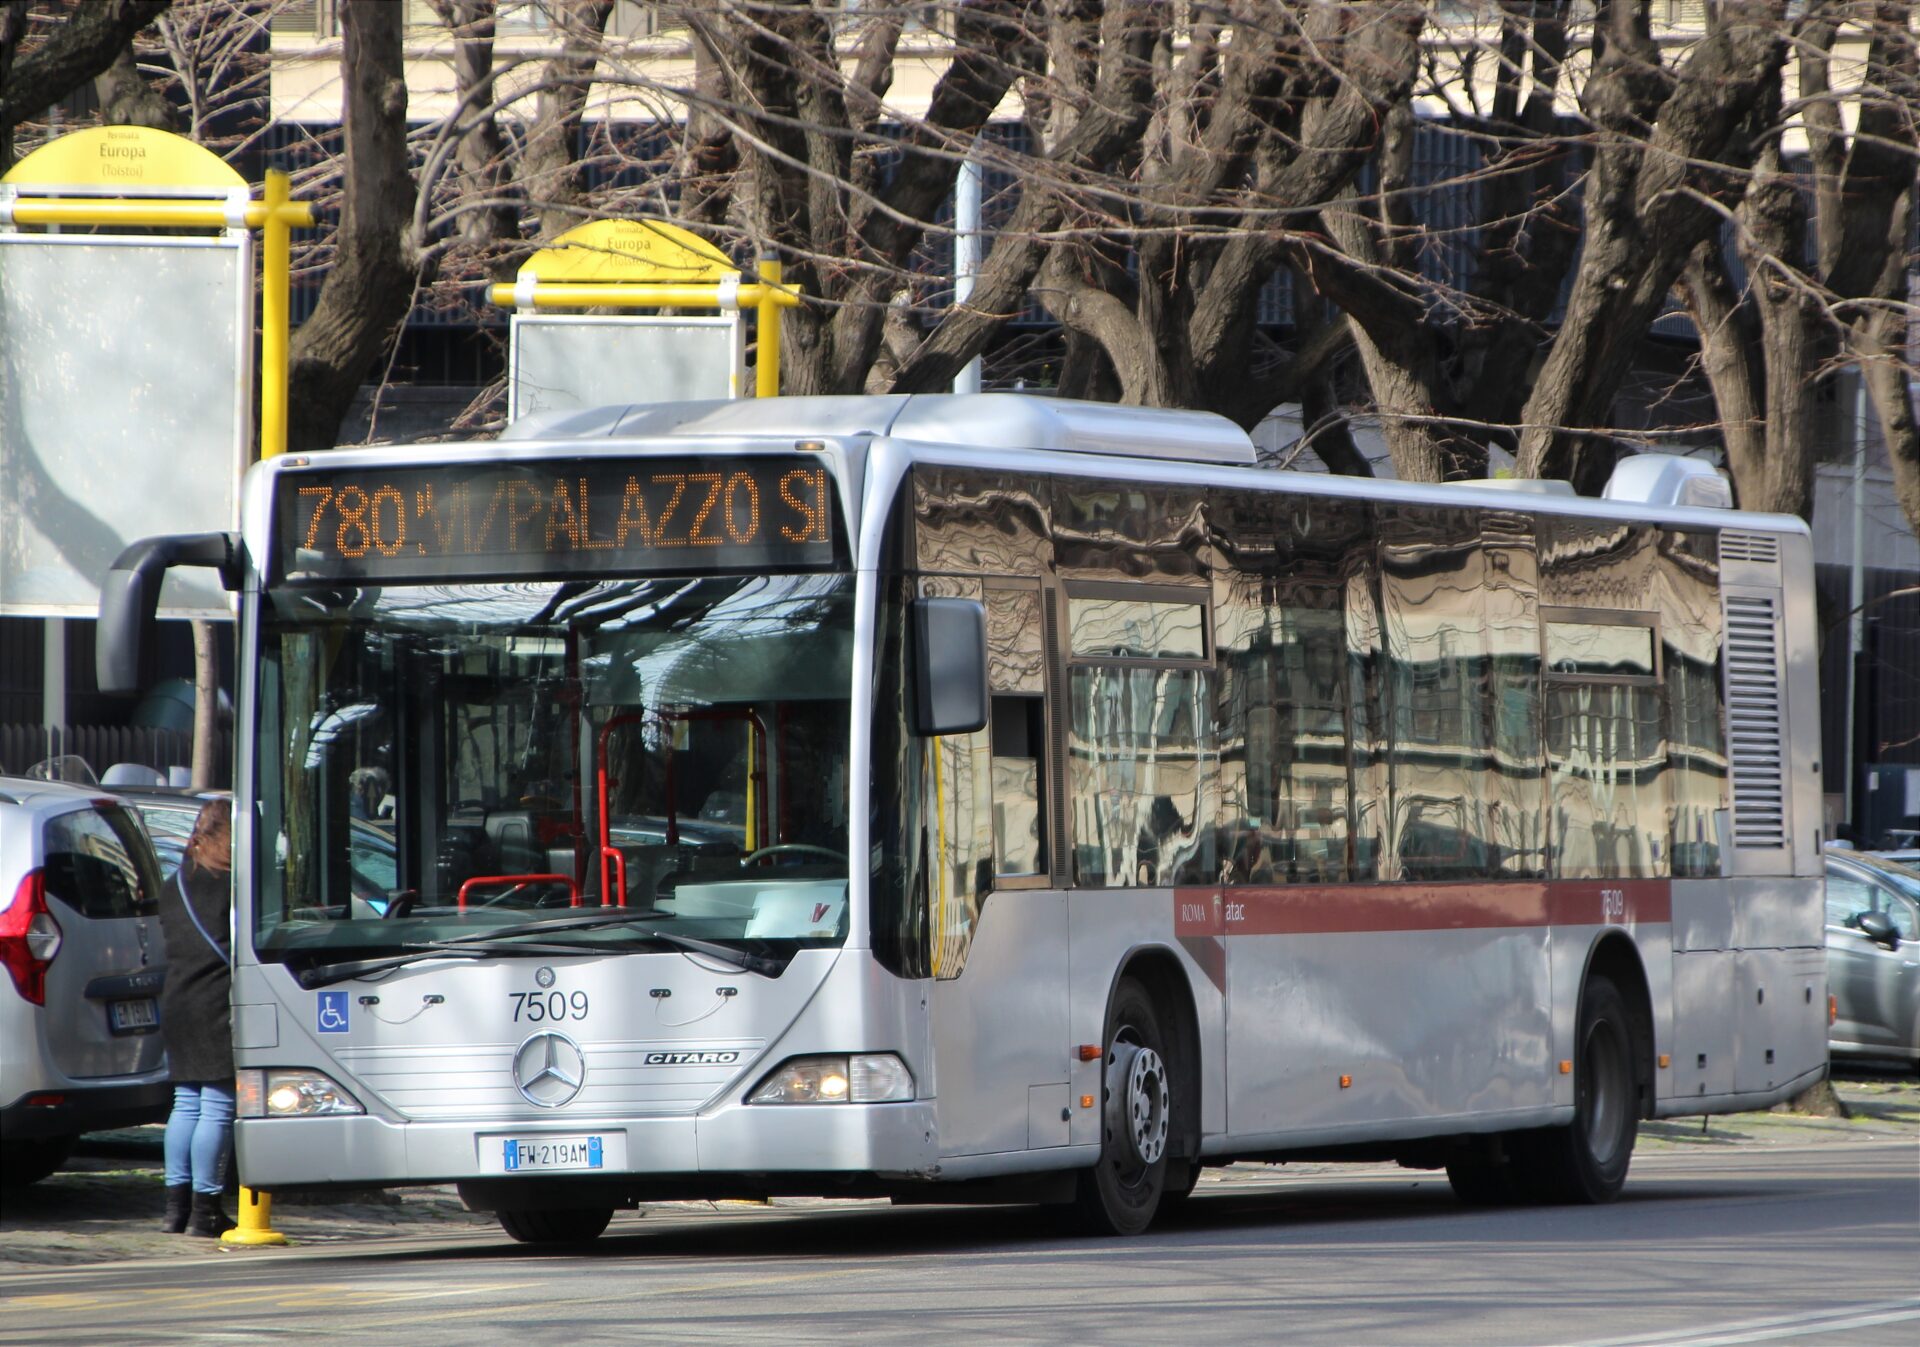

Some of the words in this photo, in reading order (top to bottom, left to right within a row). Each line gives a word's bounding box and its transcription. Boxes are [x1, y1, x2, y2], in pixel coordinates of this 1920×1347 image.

[99, 142, 147, 160] Europa
[607, 236, 651, 252] Europa
[298, 484, 404, 558] 780
[1182, 903, 1206, 922] ROMA
[1225, 902, 1245, 921] atac
[1601, 889, 1624, 915] 7509
[508, 990, 589, 1022] 7509
[648, 1053, 738, 1064] CITARO
